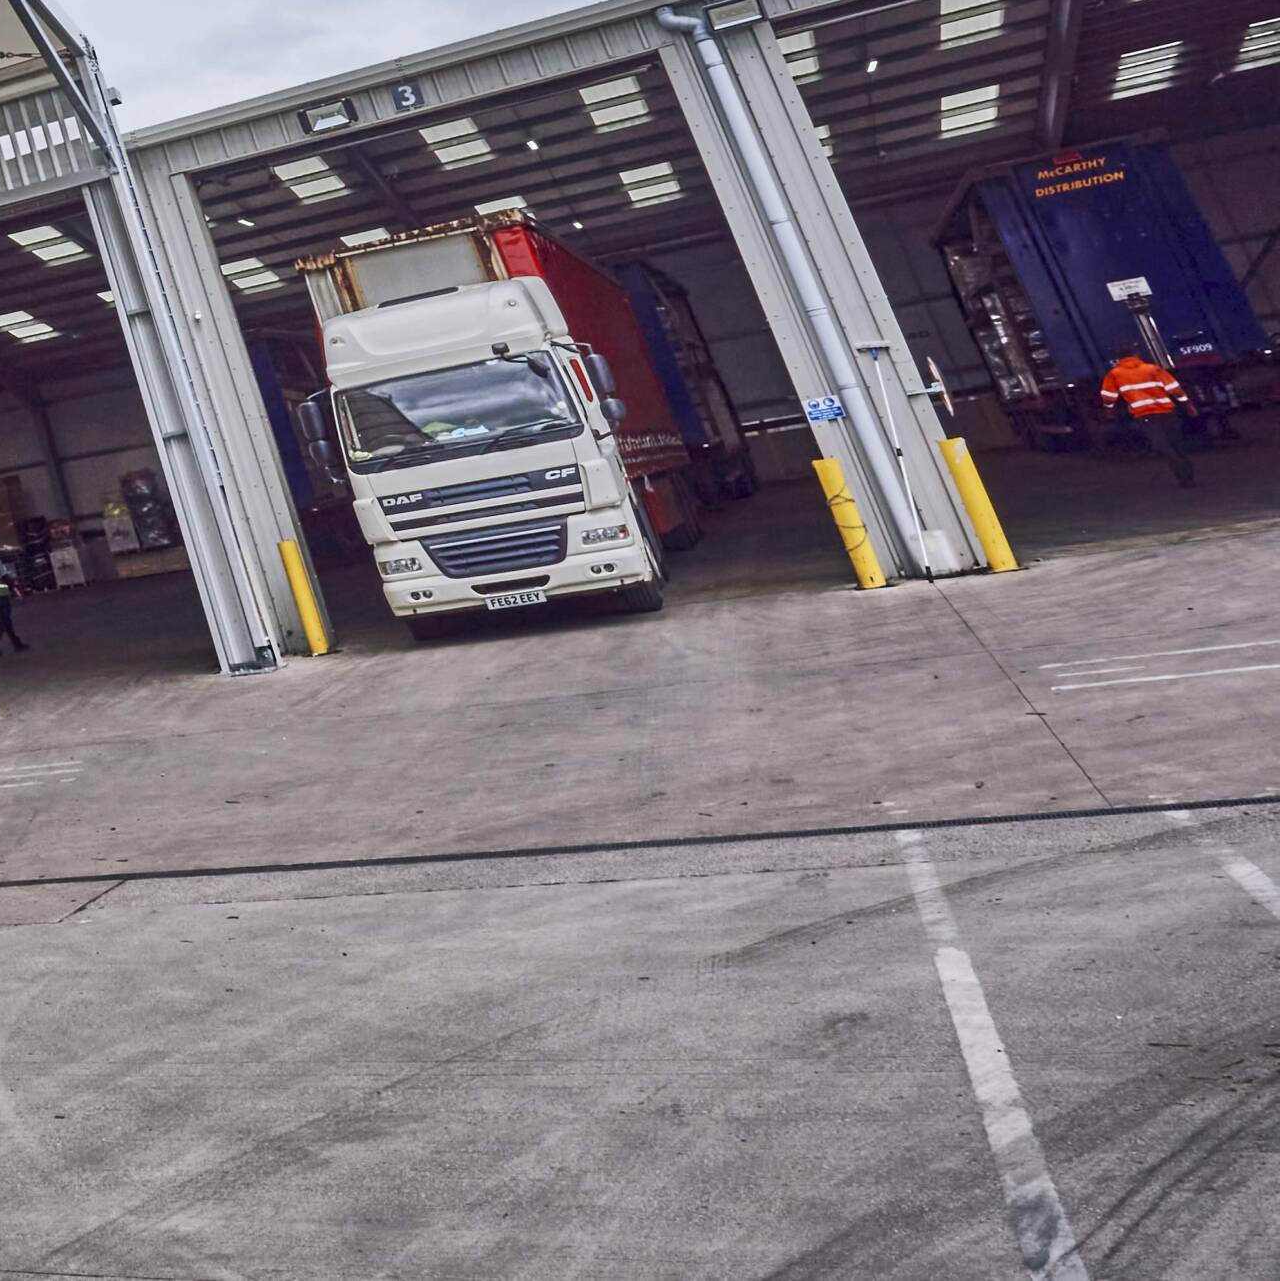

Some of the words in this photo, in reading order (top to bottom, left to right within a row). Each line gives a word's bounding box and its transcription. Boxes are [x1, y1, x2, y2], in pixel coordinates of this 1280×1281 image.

[398, 85, 416, 106] 3
[1037, 157, 1105, 179] McCARTHY
[1034, 171, 1124, 197] DISTRIBUTION
[1179, 342, 1213, 355] SF909
[544, 467, 576, 480] CF
[383, 493, 423, 507] DAF
[490, 596, 519, 608] FE62
[520, 592, 541, 604] EEY
